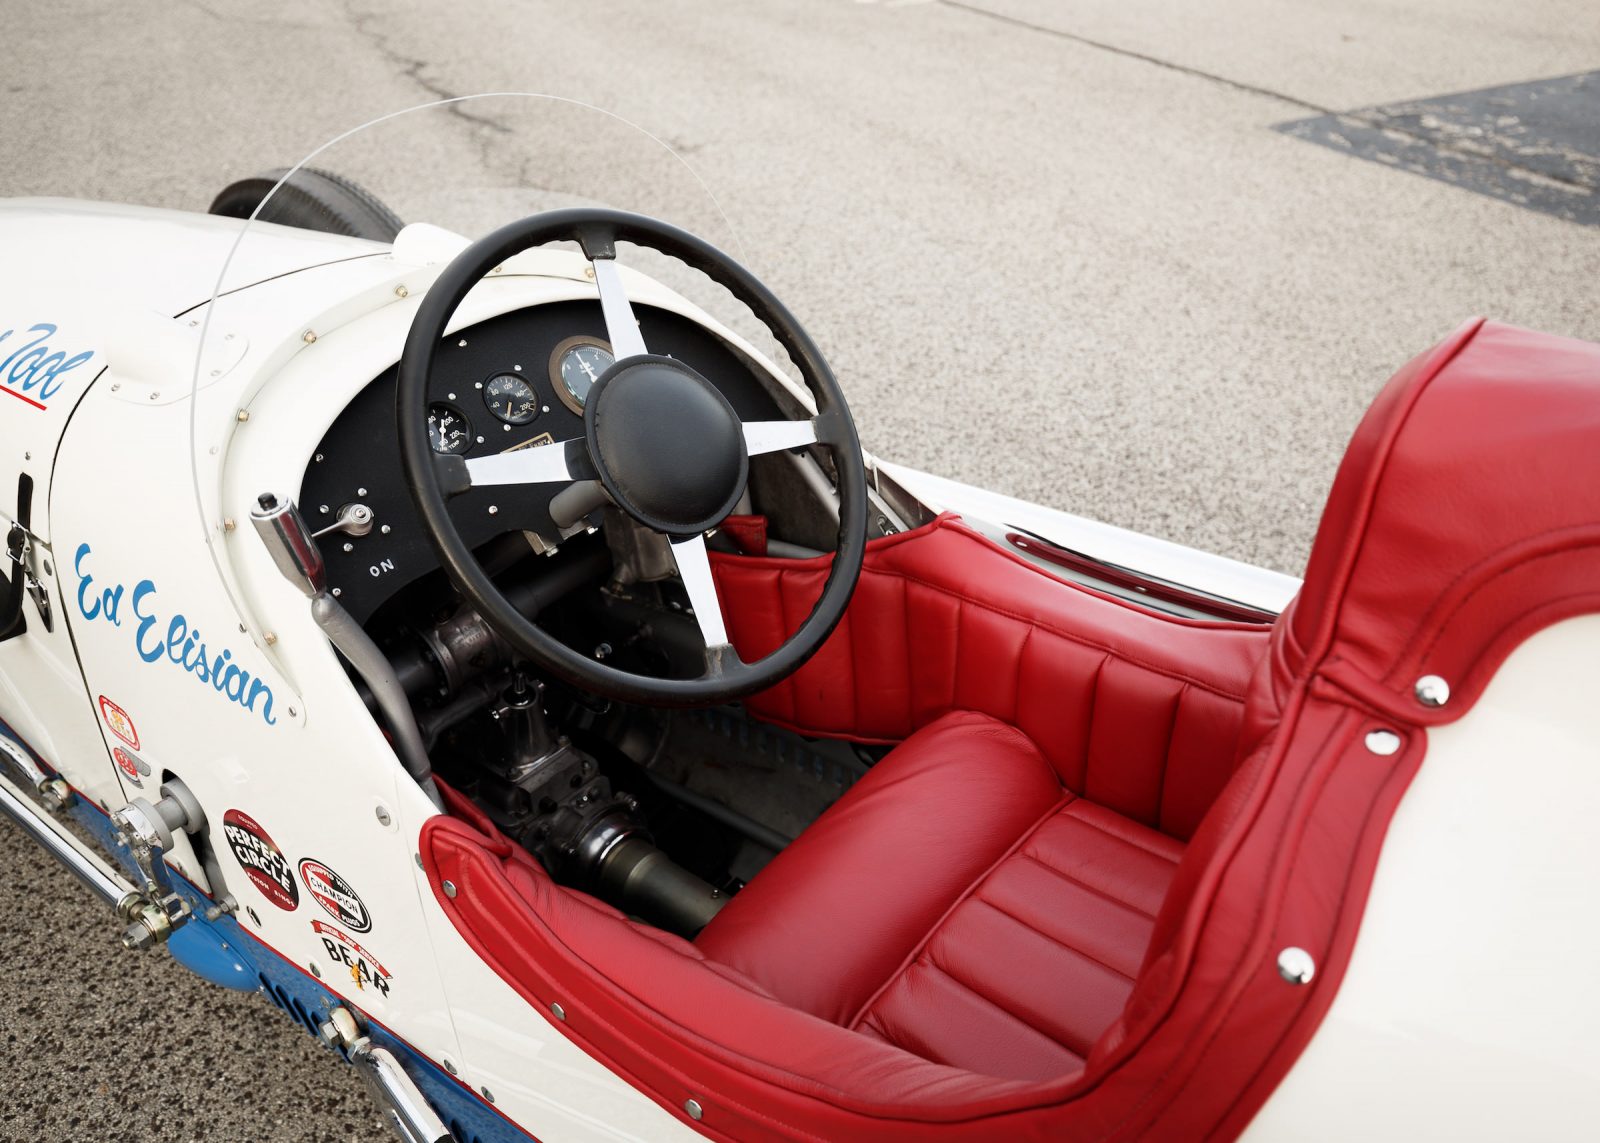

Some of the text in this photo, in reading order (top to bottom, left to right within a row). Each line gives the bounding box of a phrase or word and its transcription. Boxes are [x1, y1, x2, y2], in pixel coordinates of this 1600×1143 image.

[449, 430, 460, 440] 220
[369, 558, 395, 577] ON
[75, 543, 276, 725] Ed Elisian
[223, 825, 291, 876] PERFECT
[235, 845, 291, 893] CIRCLE
[310, 876, 359, 914] CHAMPION
[321, 936, 390, 999] BEAR
